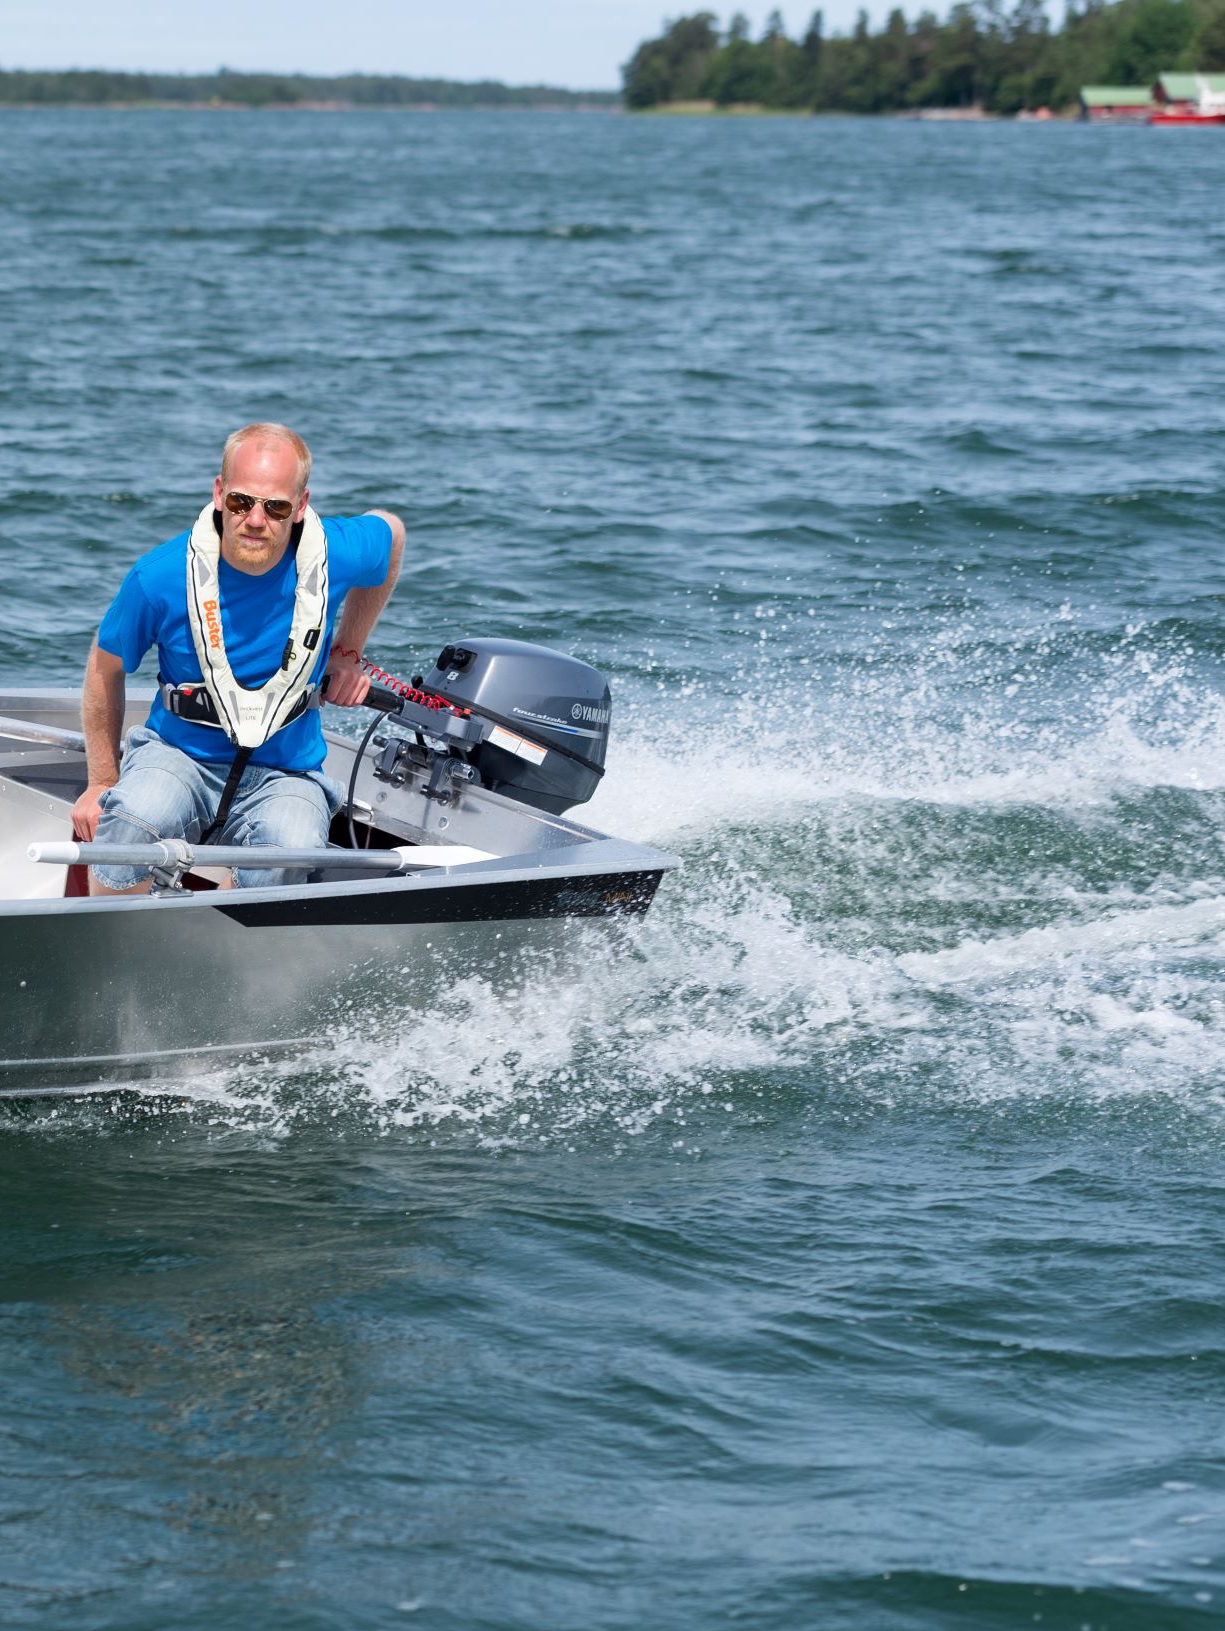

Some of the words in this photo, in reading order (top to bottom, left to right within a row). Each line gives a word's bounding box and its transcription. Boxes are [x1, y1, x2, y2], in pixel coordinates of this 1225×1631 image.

[203, 599, 220, 649] Buster
[447, 671, 459, 681] 8
[582, 705, 610, 724] YAMAHA
